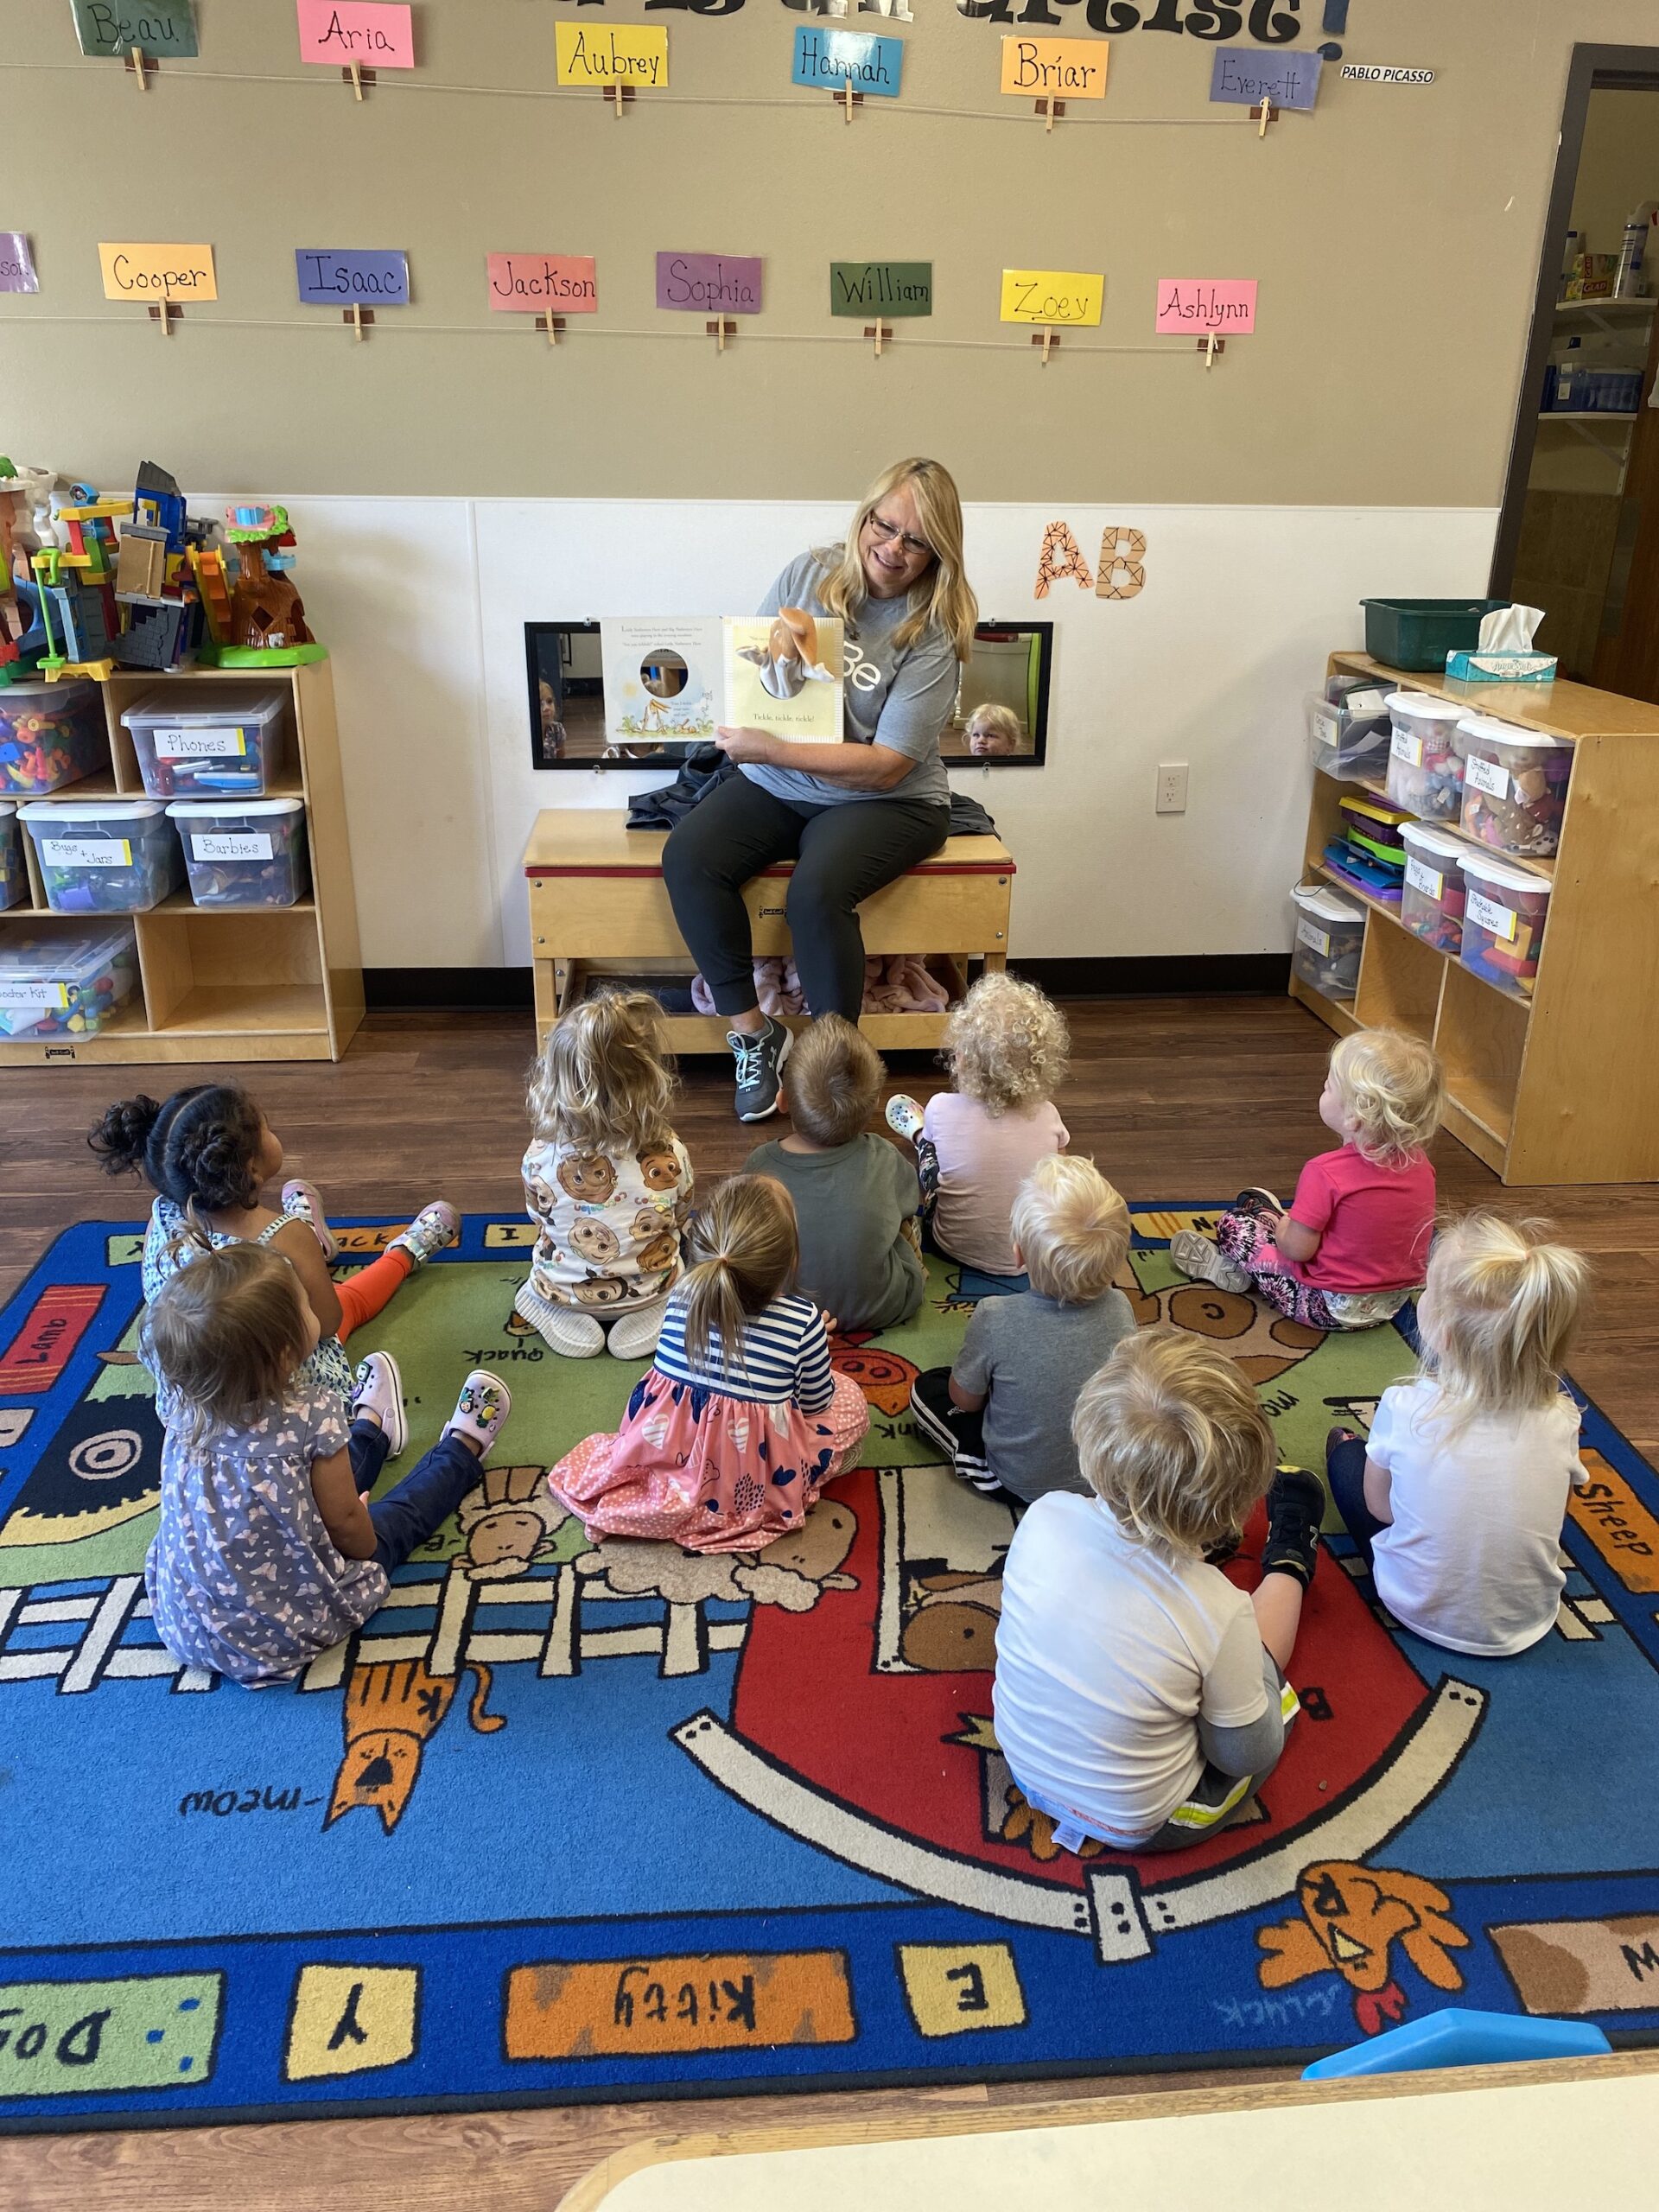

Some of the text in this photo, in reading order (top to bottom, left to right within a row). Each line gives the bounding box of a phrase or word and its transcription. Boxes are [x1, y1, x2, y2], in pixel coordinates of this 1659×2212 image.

[89, 4, 178, 43] Beau
[318, 10, 395, 52] Aria
[569, 31, 659, 84] Aubrey
[801, 36, 890, 84] Hannah
[1014, 43, 1096, 88] Briar
[1341, 66, 1433, 84] PABLO PICASSO
[1221, 60, 1300, 99] Everett
[113, 255, 207, 296] Cooper
[306, 255, 402, 294] Isaac
[493, 261, 595, 299] Jackson
[666, 260, 754, 310] Sophia
[837, 267, 929, 304] William
[1583, 282, 1607, 292] GLAD
[1014, 283, 1088, 321] Zoey
[1160, 288, 1249, 327] Ashlynn
[168, 734, 226, 753] Phones
[50, 841, 78, 855] Bugs
[86, 853, 112, 864] Jars
[203, 837, 259, 855] Barbies
[0, 986, 48, 999] octor Kit
[15, 1318, 67, 1364] Lamb
[462, 1348, 544, 1364] Quack
[1573, 1483, 1654, 1557] Sheep
[613, 1966, 755, 2031] Kitty
[946, 1962, 988, 2012] E
